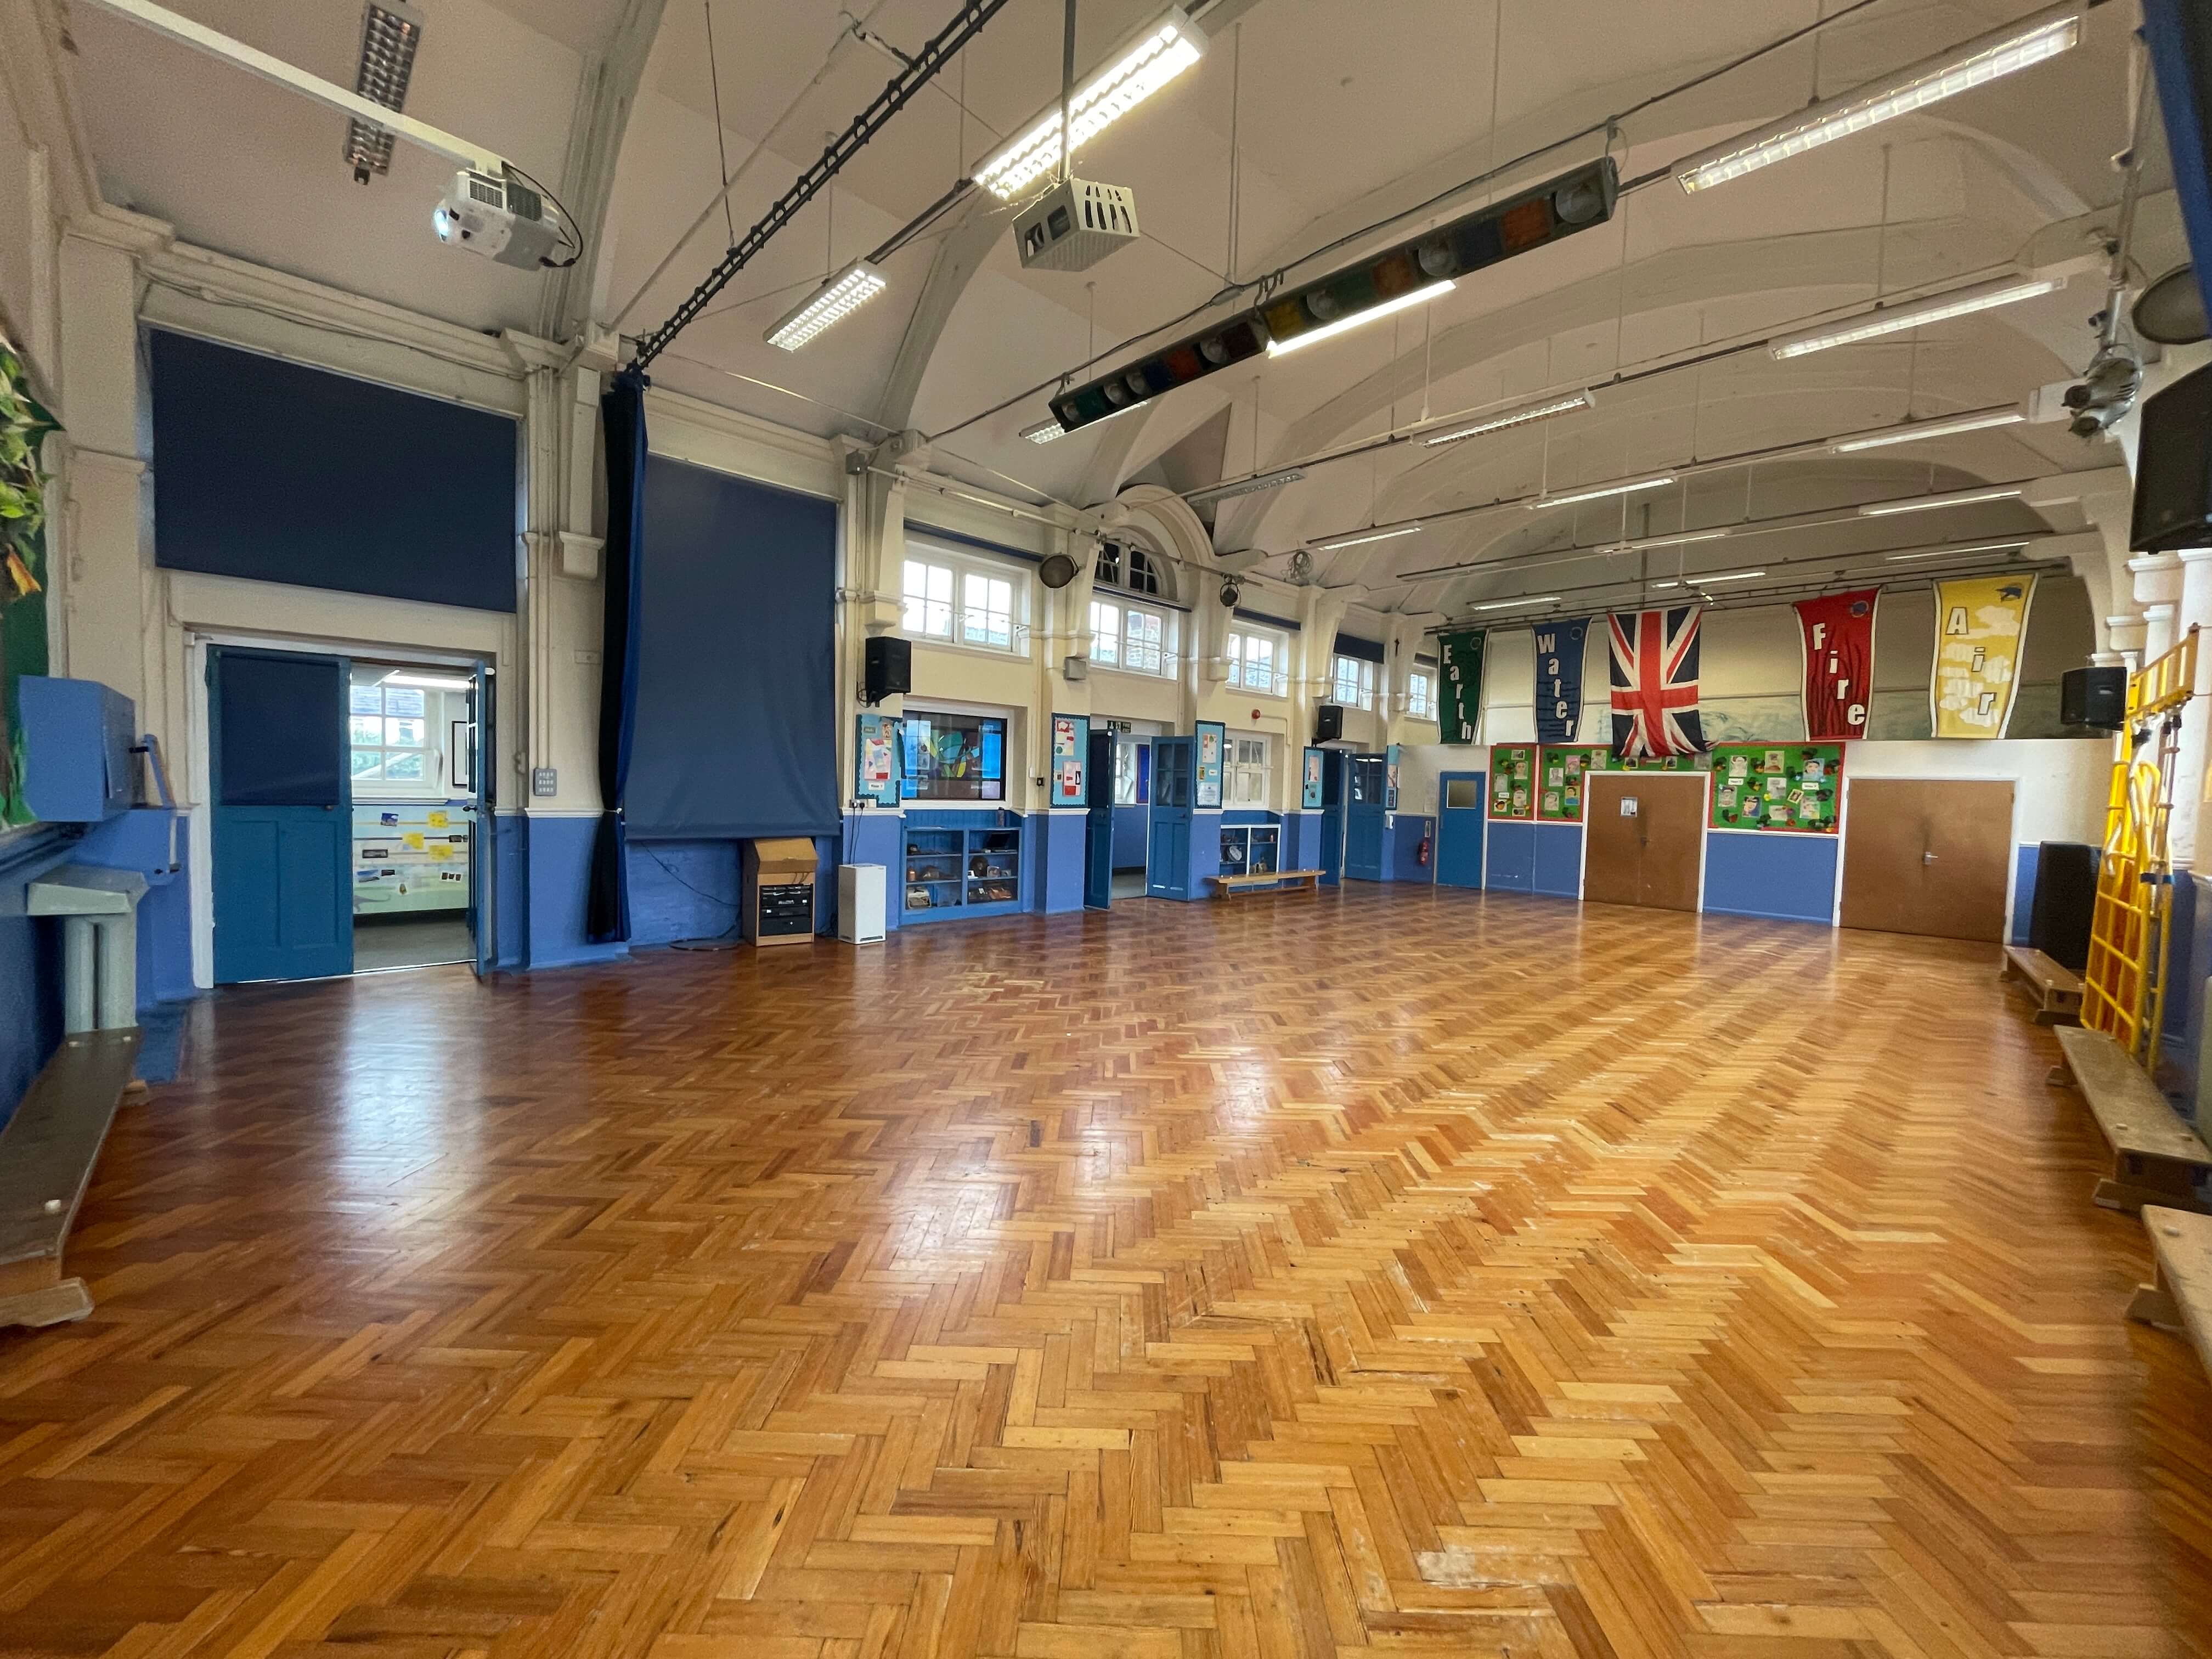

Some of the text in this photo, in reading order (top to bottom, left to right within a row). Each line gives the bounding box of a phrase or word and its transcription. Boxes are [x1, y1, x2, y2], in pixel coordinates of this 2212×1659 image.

[1443, 644, 1471, 740] Earth
[1537, 633, 1574, 737] Water
[1813, 623, 1865, 725] Fire
[1945, 607, 1997, 715] Air
